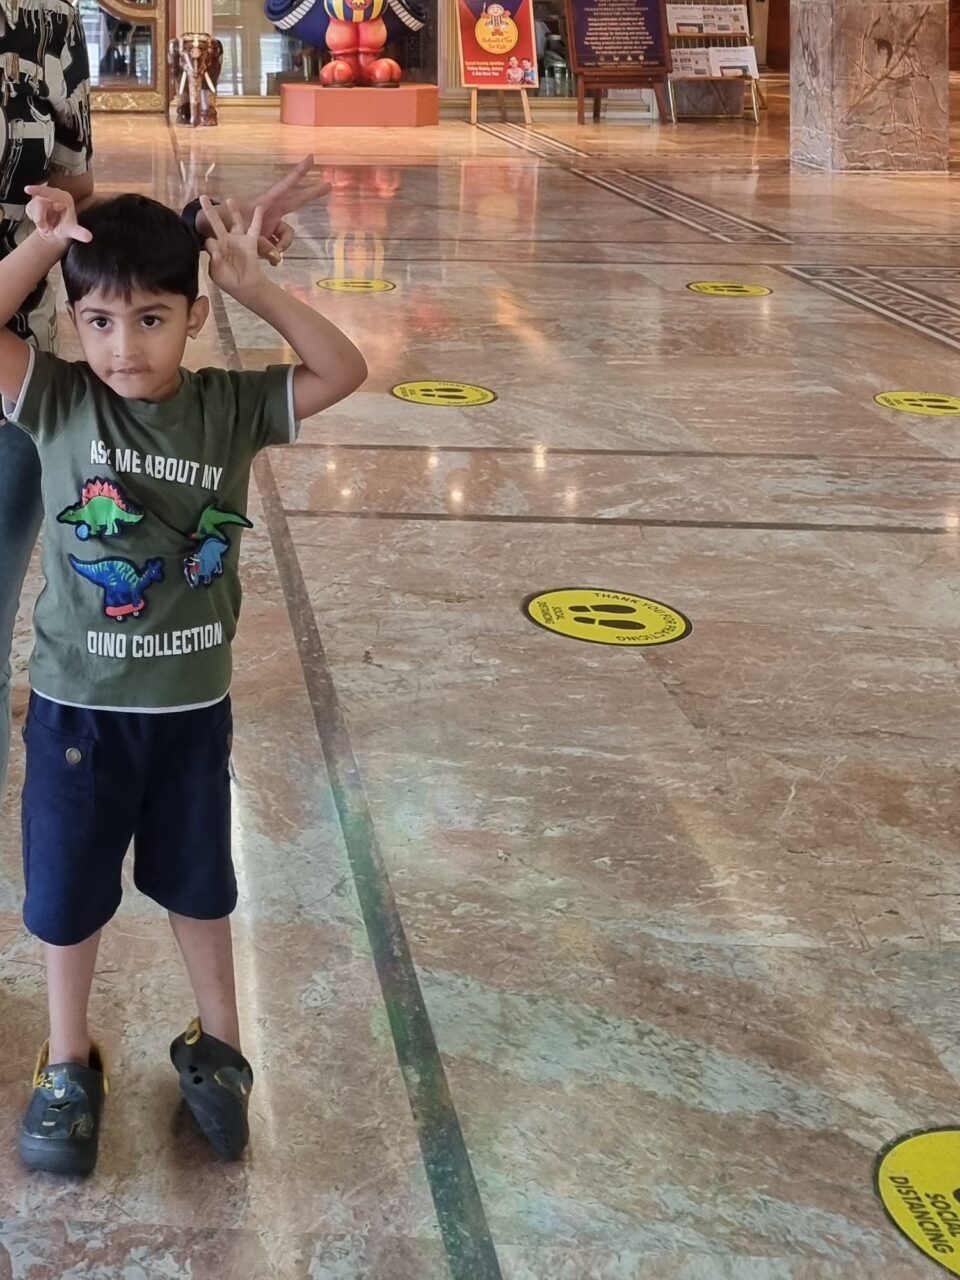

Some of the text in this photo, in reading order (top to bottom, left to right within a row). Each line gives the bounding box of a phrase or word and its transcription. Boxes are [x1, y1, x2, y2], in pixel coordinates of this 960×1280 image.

[115, 448, 141, 473] ME
[145, 454, 200, 486] ABOUT
[201, 464, 223, 491] MY
[593, 592, 638, 604] THANK
[642, 602, 666, 614] YOU
[87, 620, 222, 658] DINO COLLECTION
[889, 1175, 955, 1254] DISTANCING
